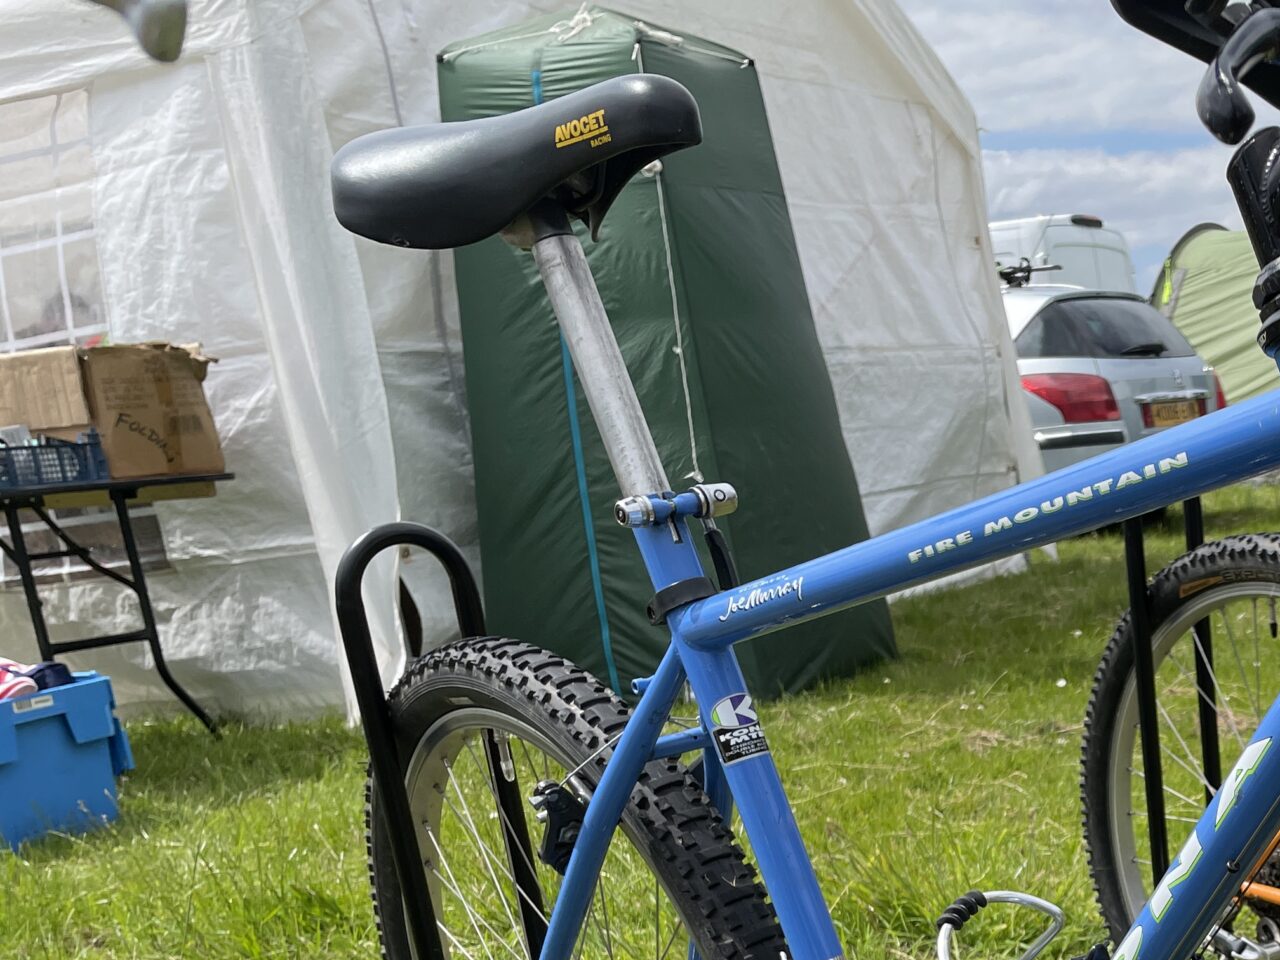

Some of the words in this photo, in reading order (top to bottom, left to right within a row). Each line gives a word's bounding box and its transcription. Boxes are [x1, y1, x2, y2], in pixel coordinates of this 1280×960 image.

[555, 109, 605, 143] AVOCET
[908, 530, 973, 564] FIRE
[984, 451, 1190, 536] MOUNTAIN
